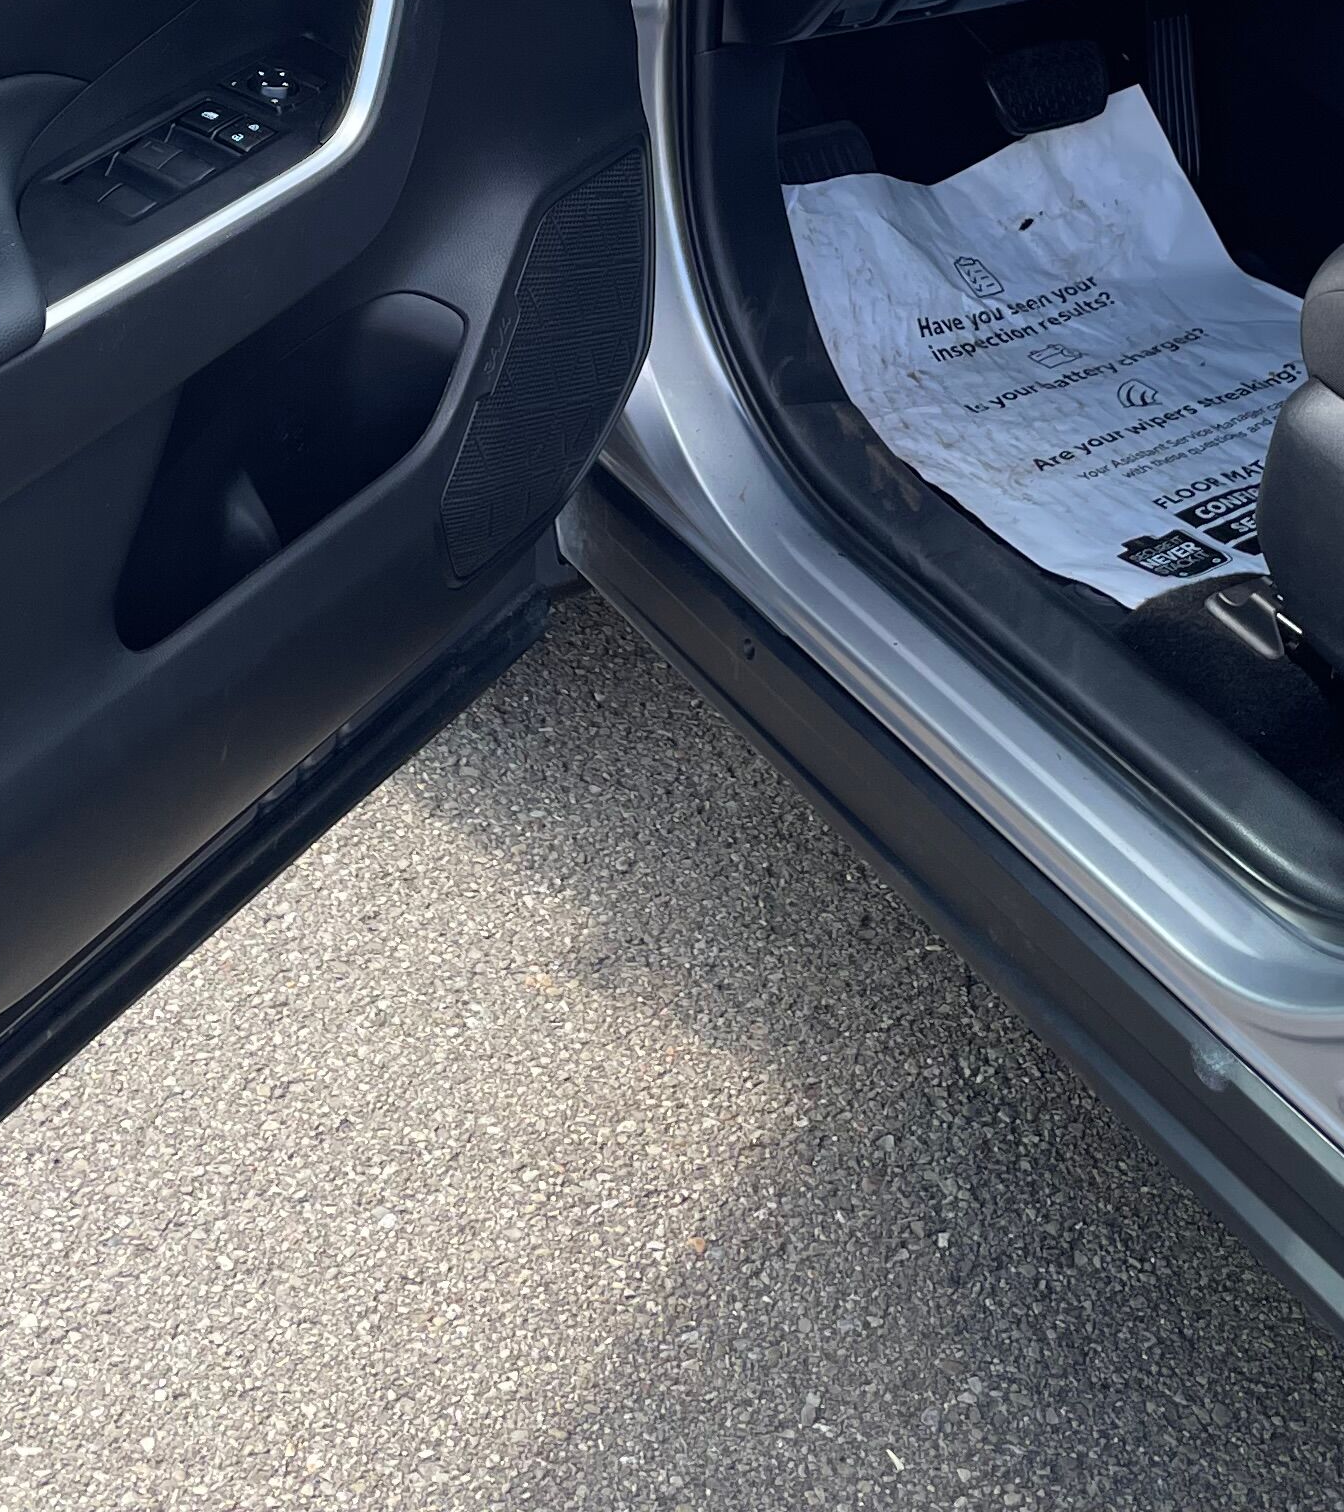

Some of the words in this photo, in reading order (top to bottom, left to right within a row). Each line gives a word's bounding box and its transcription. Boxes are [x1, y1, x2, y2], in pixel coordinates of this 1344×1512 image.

[917, 316, 965, 338] Have
[965, 307, 1004, 331] you
[1007, 295, 1053, 315] seen
[1051, 276, 1098, 304] your
[928, 324, 1039, 363] inspection
[1039, 292, 1116, 331] results?
[964, 402, 990, 415] Is
[989, 385, 1038, 409] your
[1037, 361, 1119, 393] battery
[1118, 327, 1209, 367] charged?
[1033, 449, 1076, 472] Are
[1073, 429, 1125, 455] your
[1126, 403, 1198, 436] wipers
[1197, 363, 1302, 408] streaking?
[1077, 464, 1109, 481] Your
[1110, 444, 1170, 469] Assistant
[1166, 426, 1213, 448] Service
[1211, 406, 1267, 431] Manager
[1122, 463, 1153, 479] with
[1151, 450, 1188, 467] these
[1188, 430, 1248, 456] questions
[1247, 416, 1274, 433] and
[1152, 477, 1226, 510] FLOOR
[1140, 541, 1201, 569] NEVER
